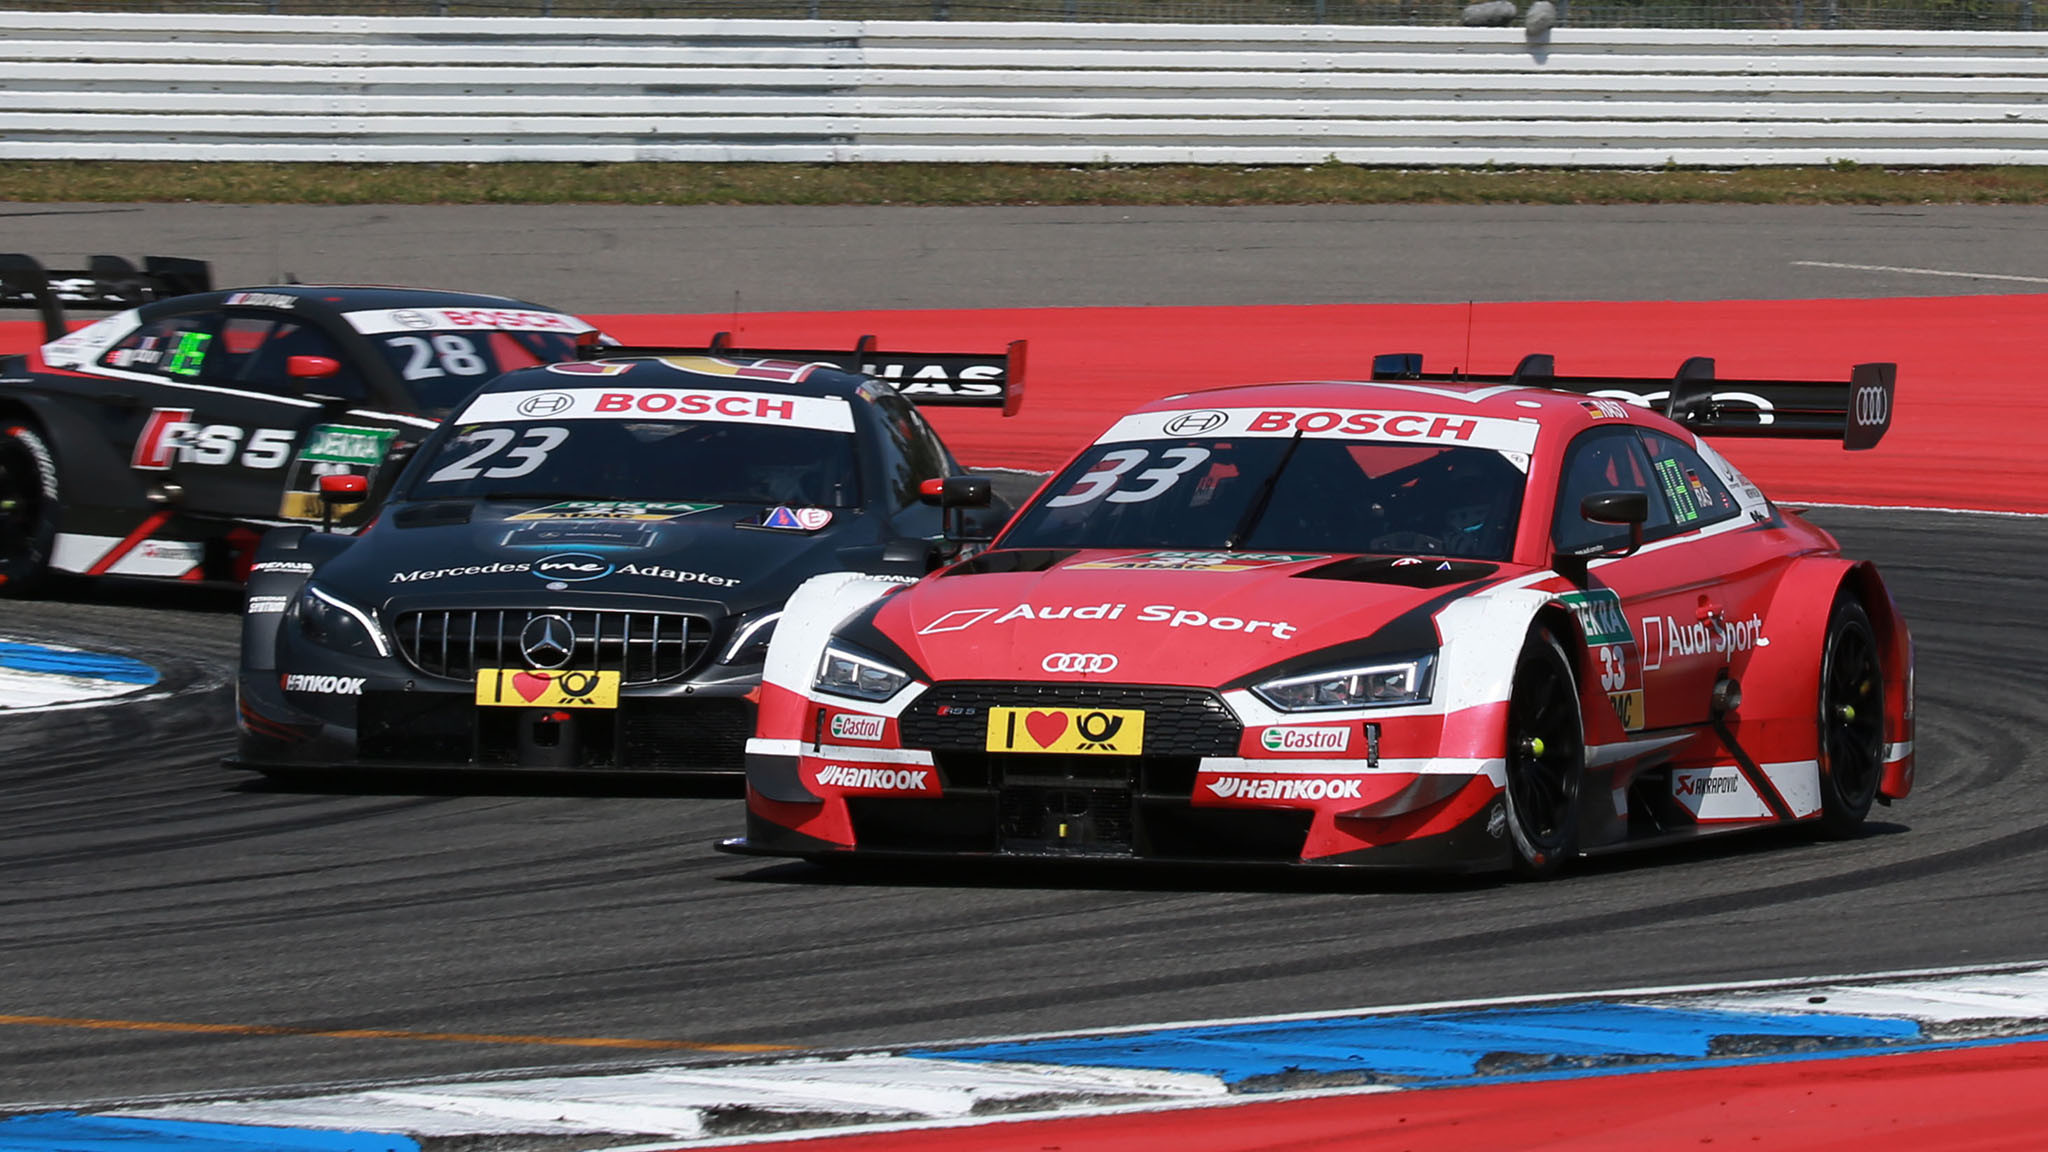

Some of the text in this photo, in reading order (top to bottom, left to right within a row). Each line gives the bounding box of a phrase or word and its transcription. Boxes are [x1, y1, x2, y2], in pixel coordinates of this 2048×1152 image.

[385, 335, 487, 380] 28
[594, 393, 794, 420] BOSCH
[1245, 411, 1478, 440] BOSCH
[427, 427, 570, 482] 23
[1045, 447, 1211, 507] 33
[568, 503, 696, 511] DEKRA
[254, 562, 314, 571] REMUS
[389, 562, 530, 583] Mercedes
[540, 560, 605, 572] me
[616, 564, 741, 588] Adapter
[994, 603, 1297, 640] Audi Sport
[1667, 615, 1711, 656] Audi
[1600, 646, 1626, 692] 33
[842, 718, 879, 736] Castrol
[1284, 730, 1343, 748] Castrol
[831, 766, 927, 790] HANKOOK
[1236, 779, 1362, 800] HANKOOK
